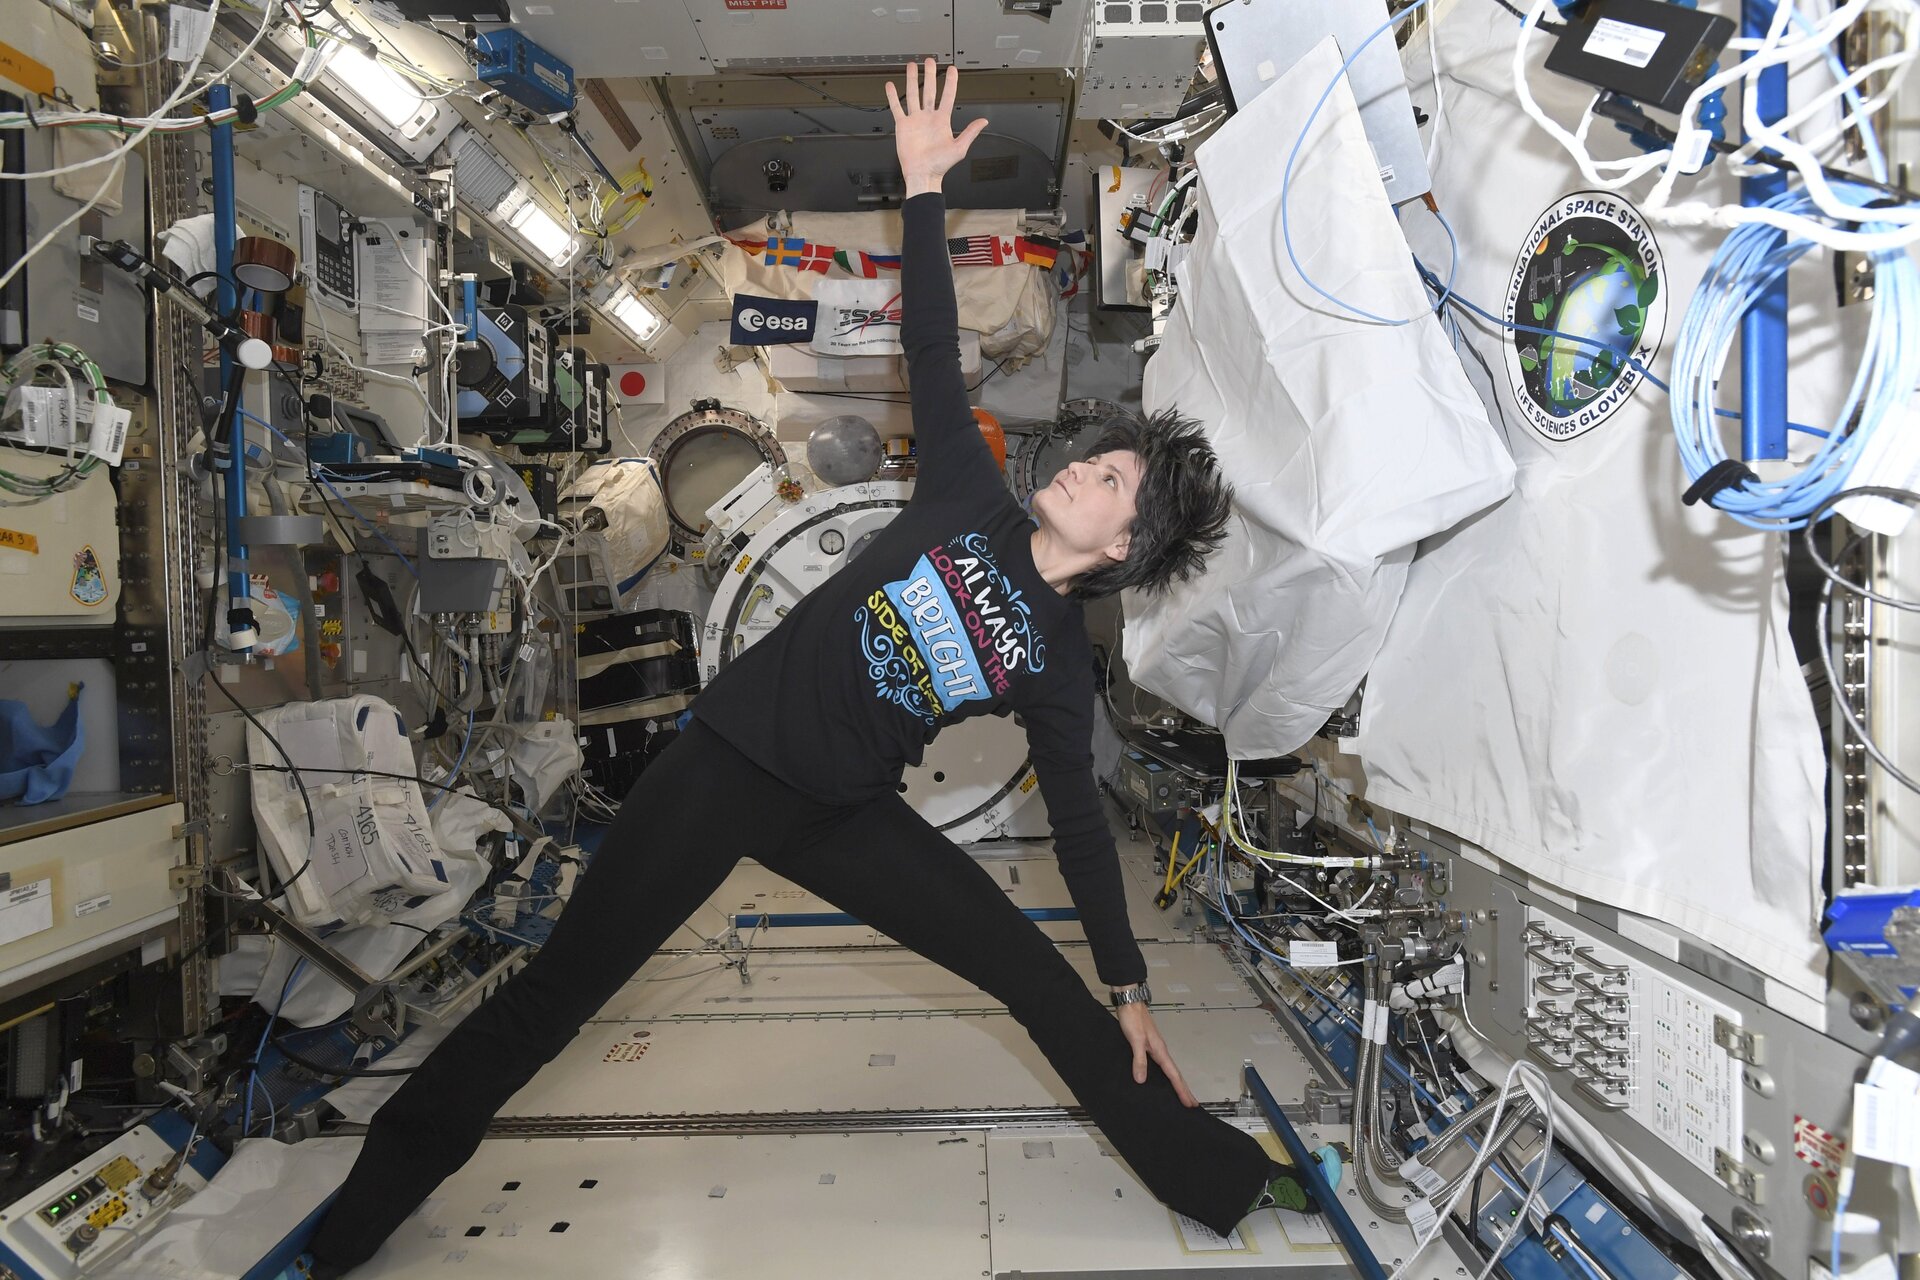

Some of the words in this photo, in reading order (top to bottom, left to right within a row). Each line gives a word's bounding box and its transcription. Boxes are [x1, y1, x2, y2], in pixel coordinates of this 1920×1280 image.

[1506, 209, 1564, 333] INTERNATIONAL
[1565, 199, 1617, 218] SPACE
[1617, 208, 1659, 274] STATION
[765, 314, 808, 331] esa
[1516, 384, 1534, 416] LIFE
[1533, 411, 1577, 436] SCIENCES
[17, 533, 25, 545] 3
[867, 590, 909, 646] SIDE
[901, 645, 925, 676] OF
[899, 575, 980, 698] BRIGHT
[927, 545, 972, 609] LOOK
[964, 610, 994, 650] ON
[983, 650, 1011, 695] THE
[954, 556, 1027, 671] ALWAYS
[1405, 1181, 1421, 1194] EPS
